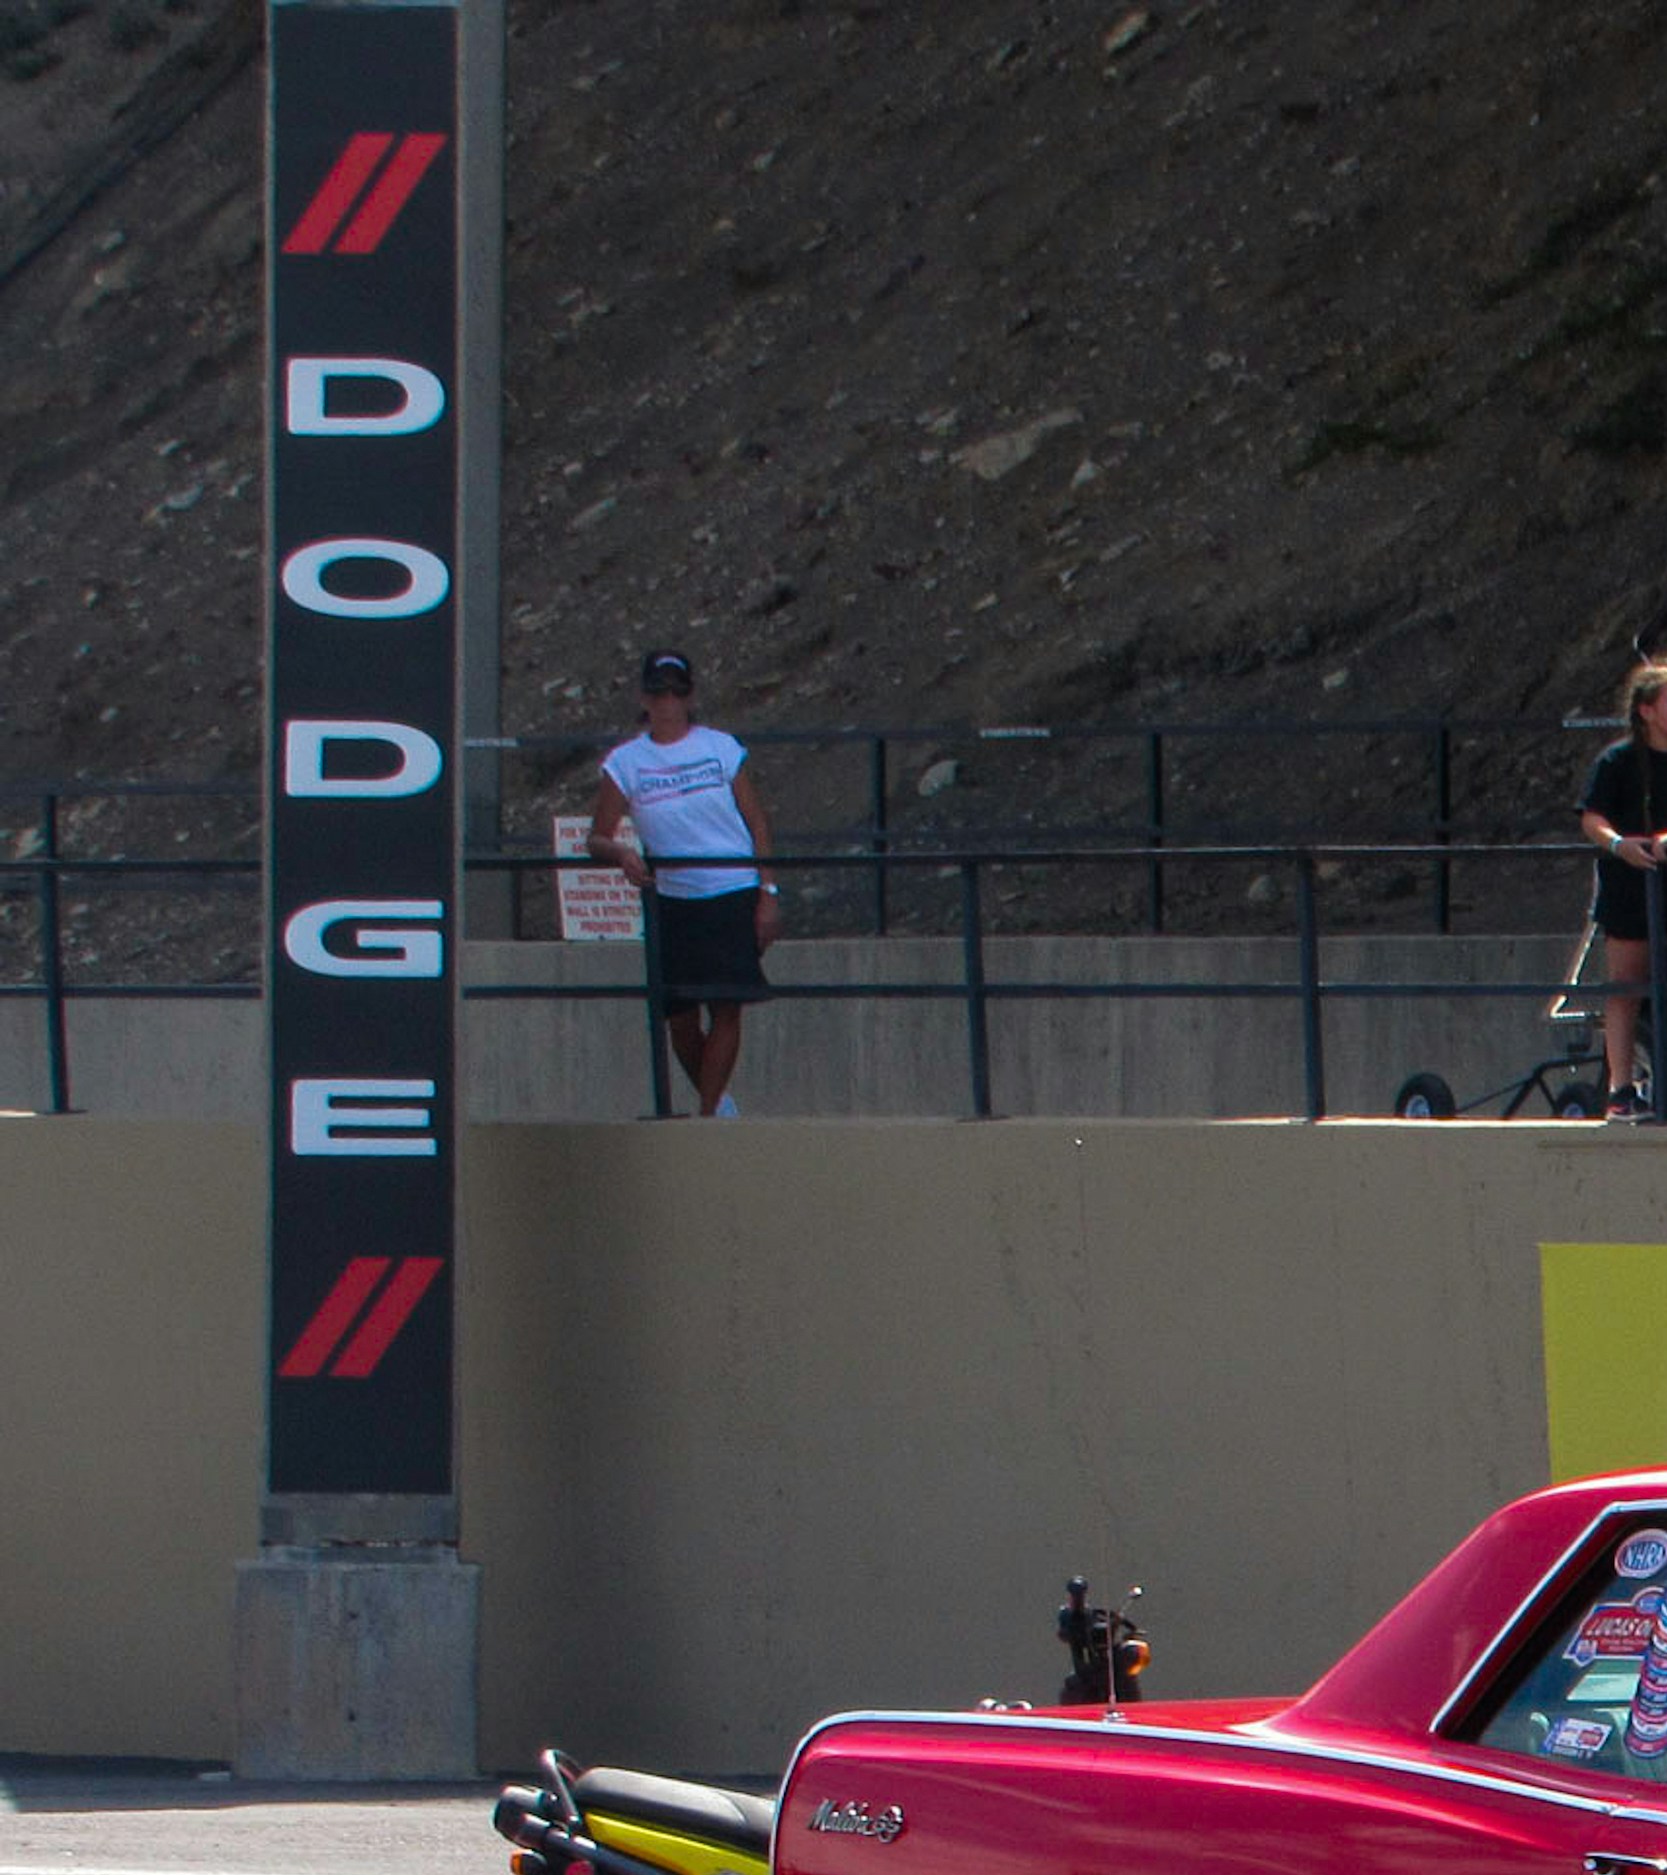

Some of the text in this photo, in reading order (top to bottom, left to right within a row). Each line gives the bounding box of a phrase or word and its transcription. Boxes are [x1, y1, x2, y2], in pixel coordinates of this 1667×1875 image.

[282, 357, 449, 1156] DODGE
[1623, 1543, 1666, 1570] NHRA
[806, 1798, 876, 1836] Malibu
